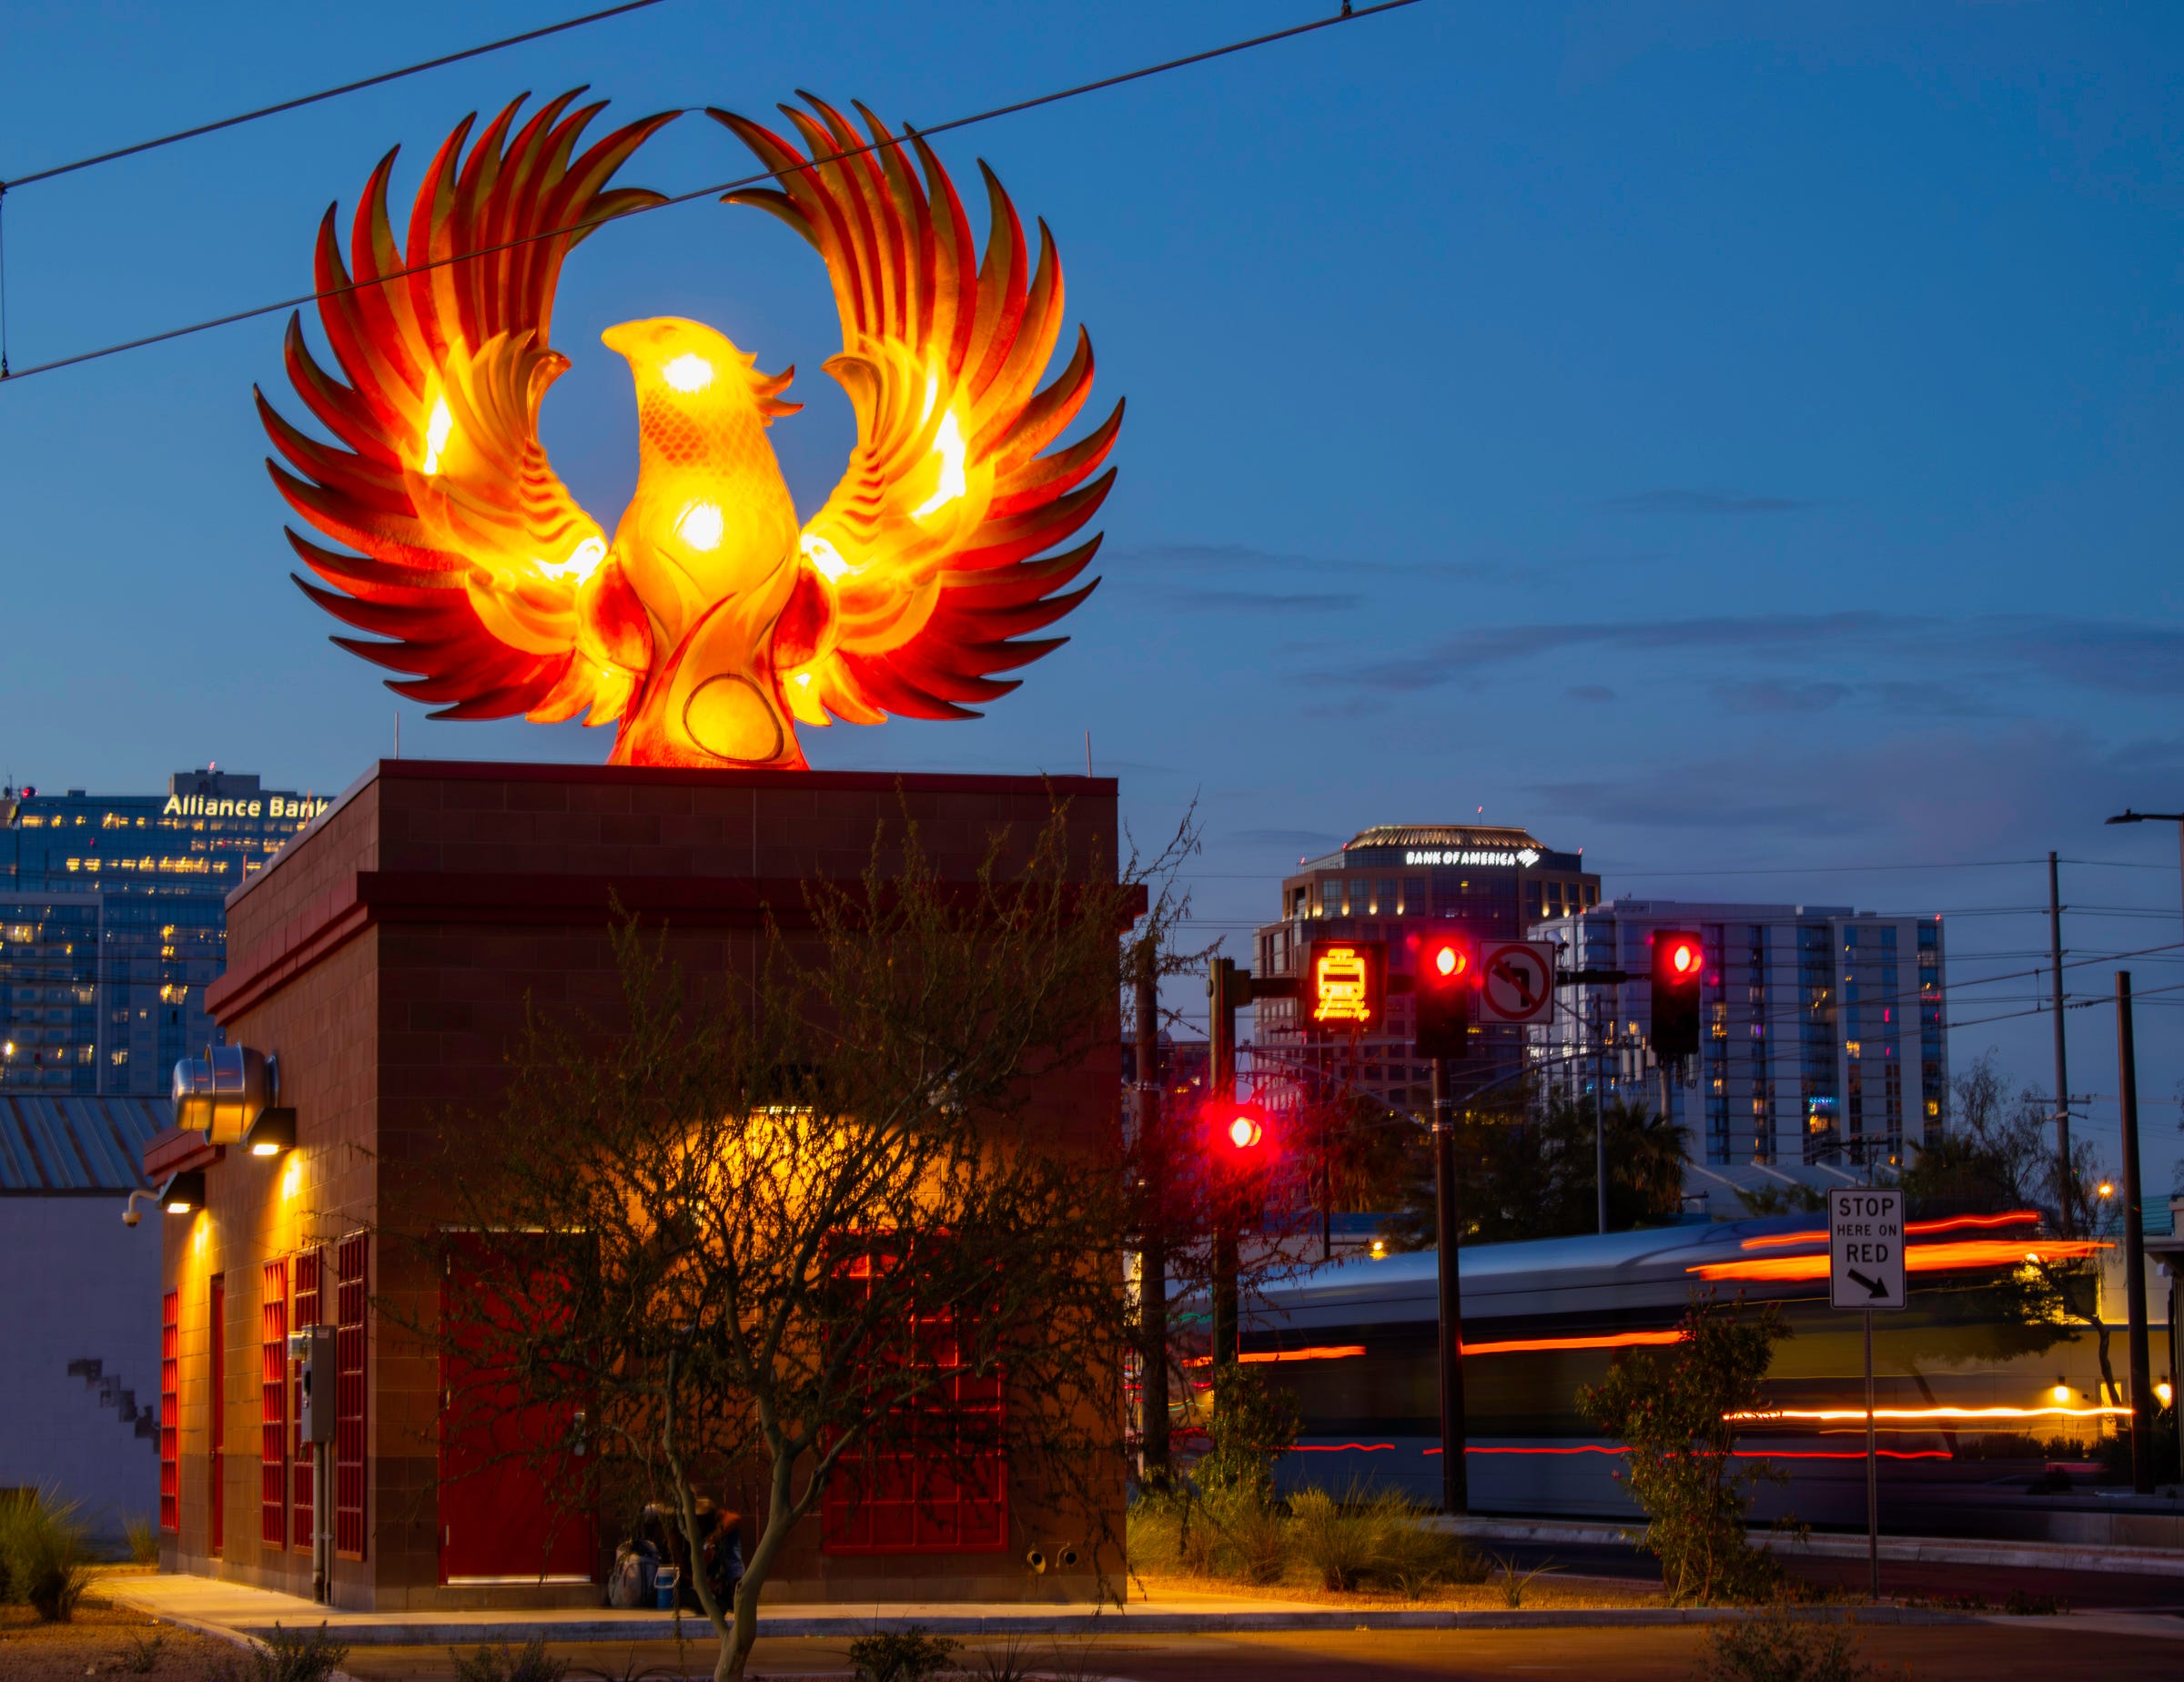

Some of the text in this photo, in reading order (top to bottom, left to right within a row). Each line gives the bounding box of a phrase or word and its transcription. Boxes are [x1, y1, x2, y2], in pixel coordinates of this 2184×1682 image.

[163, 795, 329, 817] Alliance Bank
[1406, 851, 1515, 866] BANK OF AMERICA
[1839, 1198, 1894, 1217] STOP
[1837, 1224, 1897, 1236] HERE ON
[1846, 1243, 1888, 1263] RED
